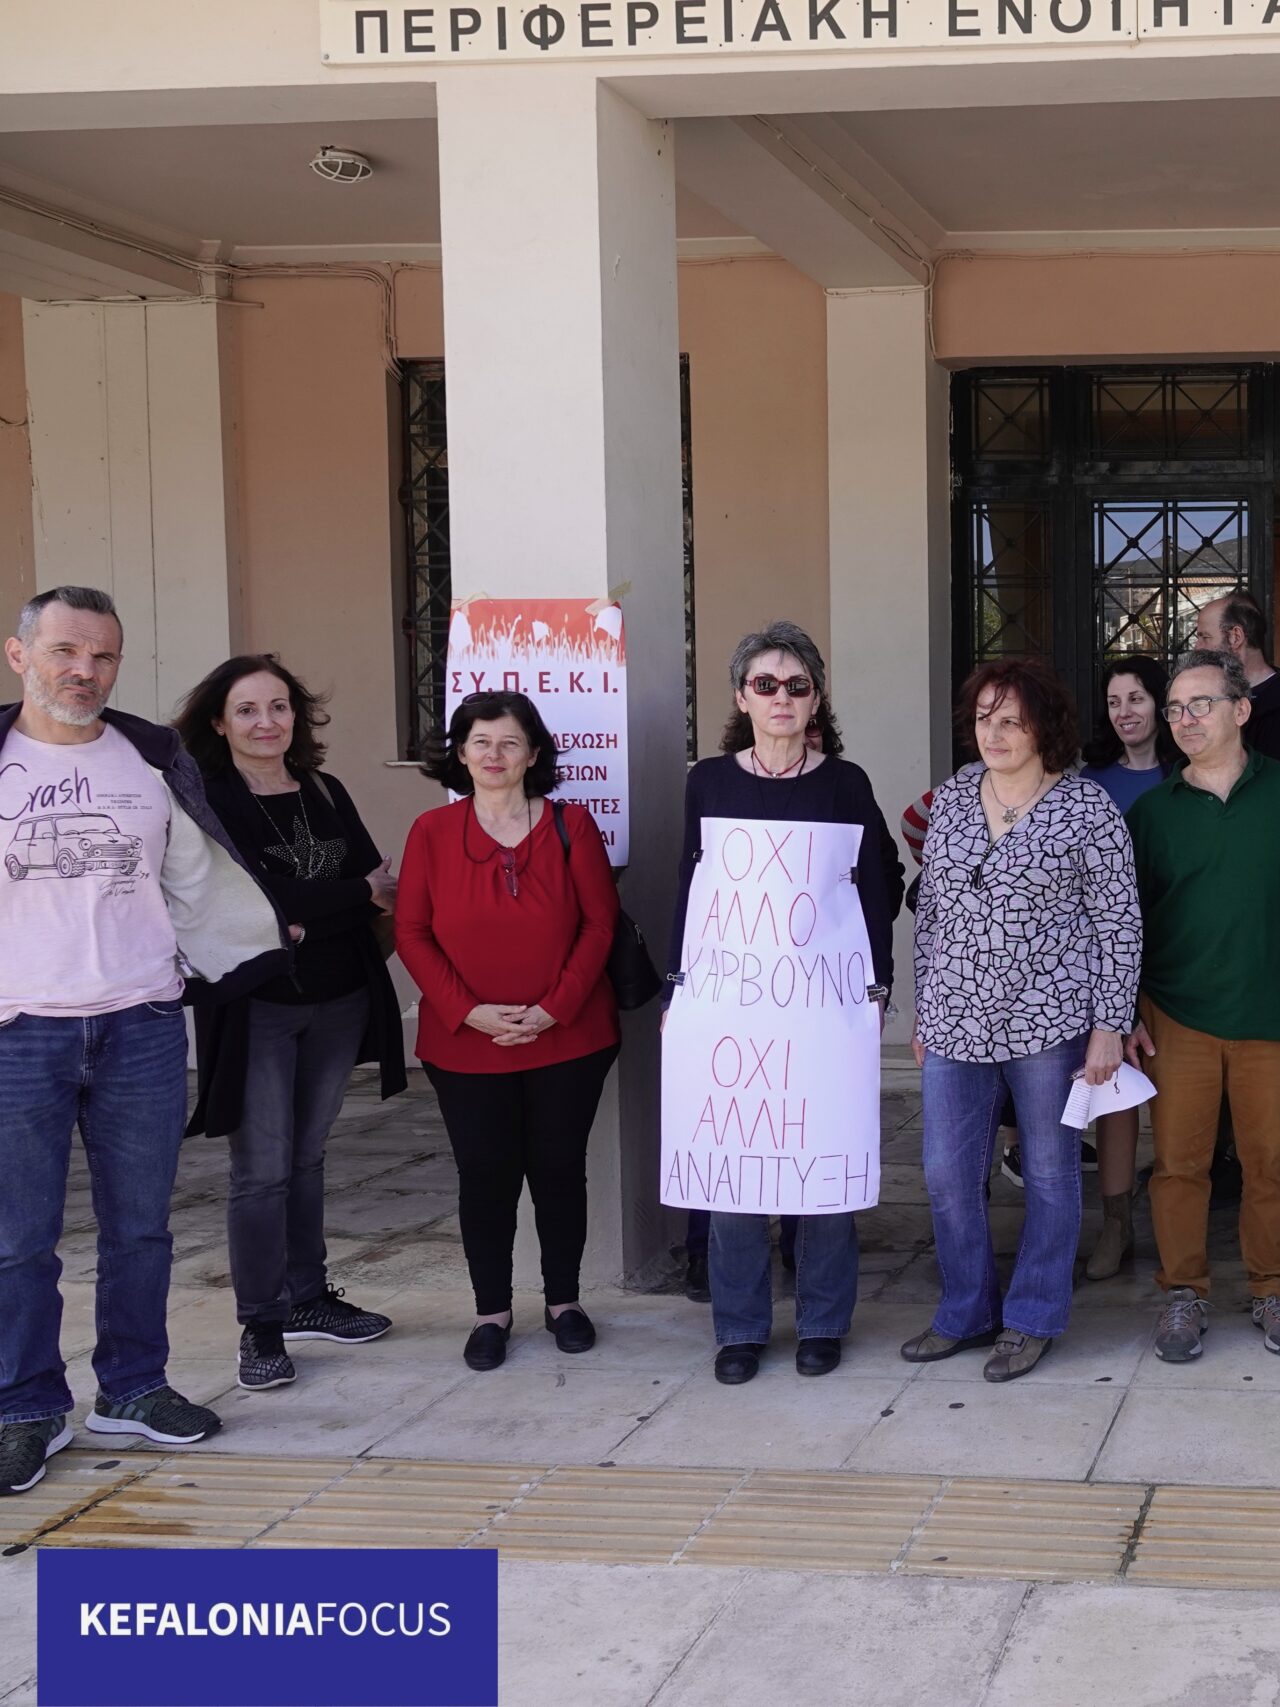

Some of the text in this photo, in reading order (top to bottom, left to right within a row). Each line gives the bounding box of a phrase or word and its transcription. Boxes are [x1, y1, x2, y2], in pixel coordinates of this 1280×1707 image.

[354, 0, 898, 54] ΠΕΡΙΦΕΡΕΙΑΚΗ
[0, 762, 92, 821] Crash
[722, 827, 814, 885] ΟΧΙ
[701, 888, 817, 947] ΑΛΛΟ
[679, 944, 866, 1008] ΚΑΡΒΟΥΝΟ
[711, 1035, 791, 1091] ΟΧΙ
[692, 1093, 807, 1150] ΑΛΛΗ
[665, 1148, 869, 1208] ΑΝΑΠΤΥΞΗ
